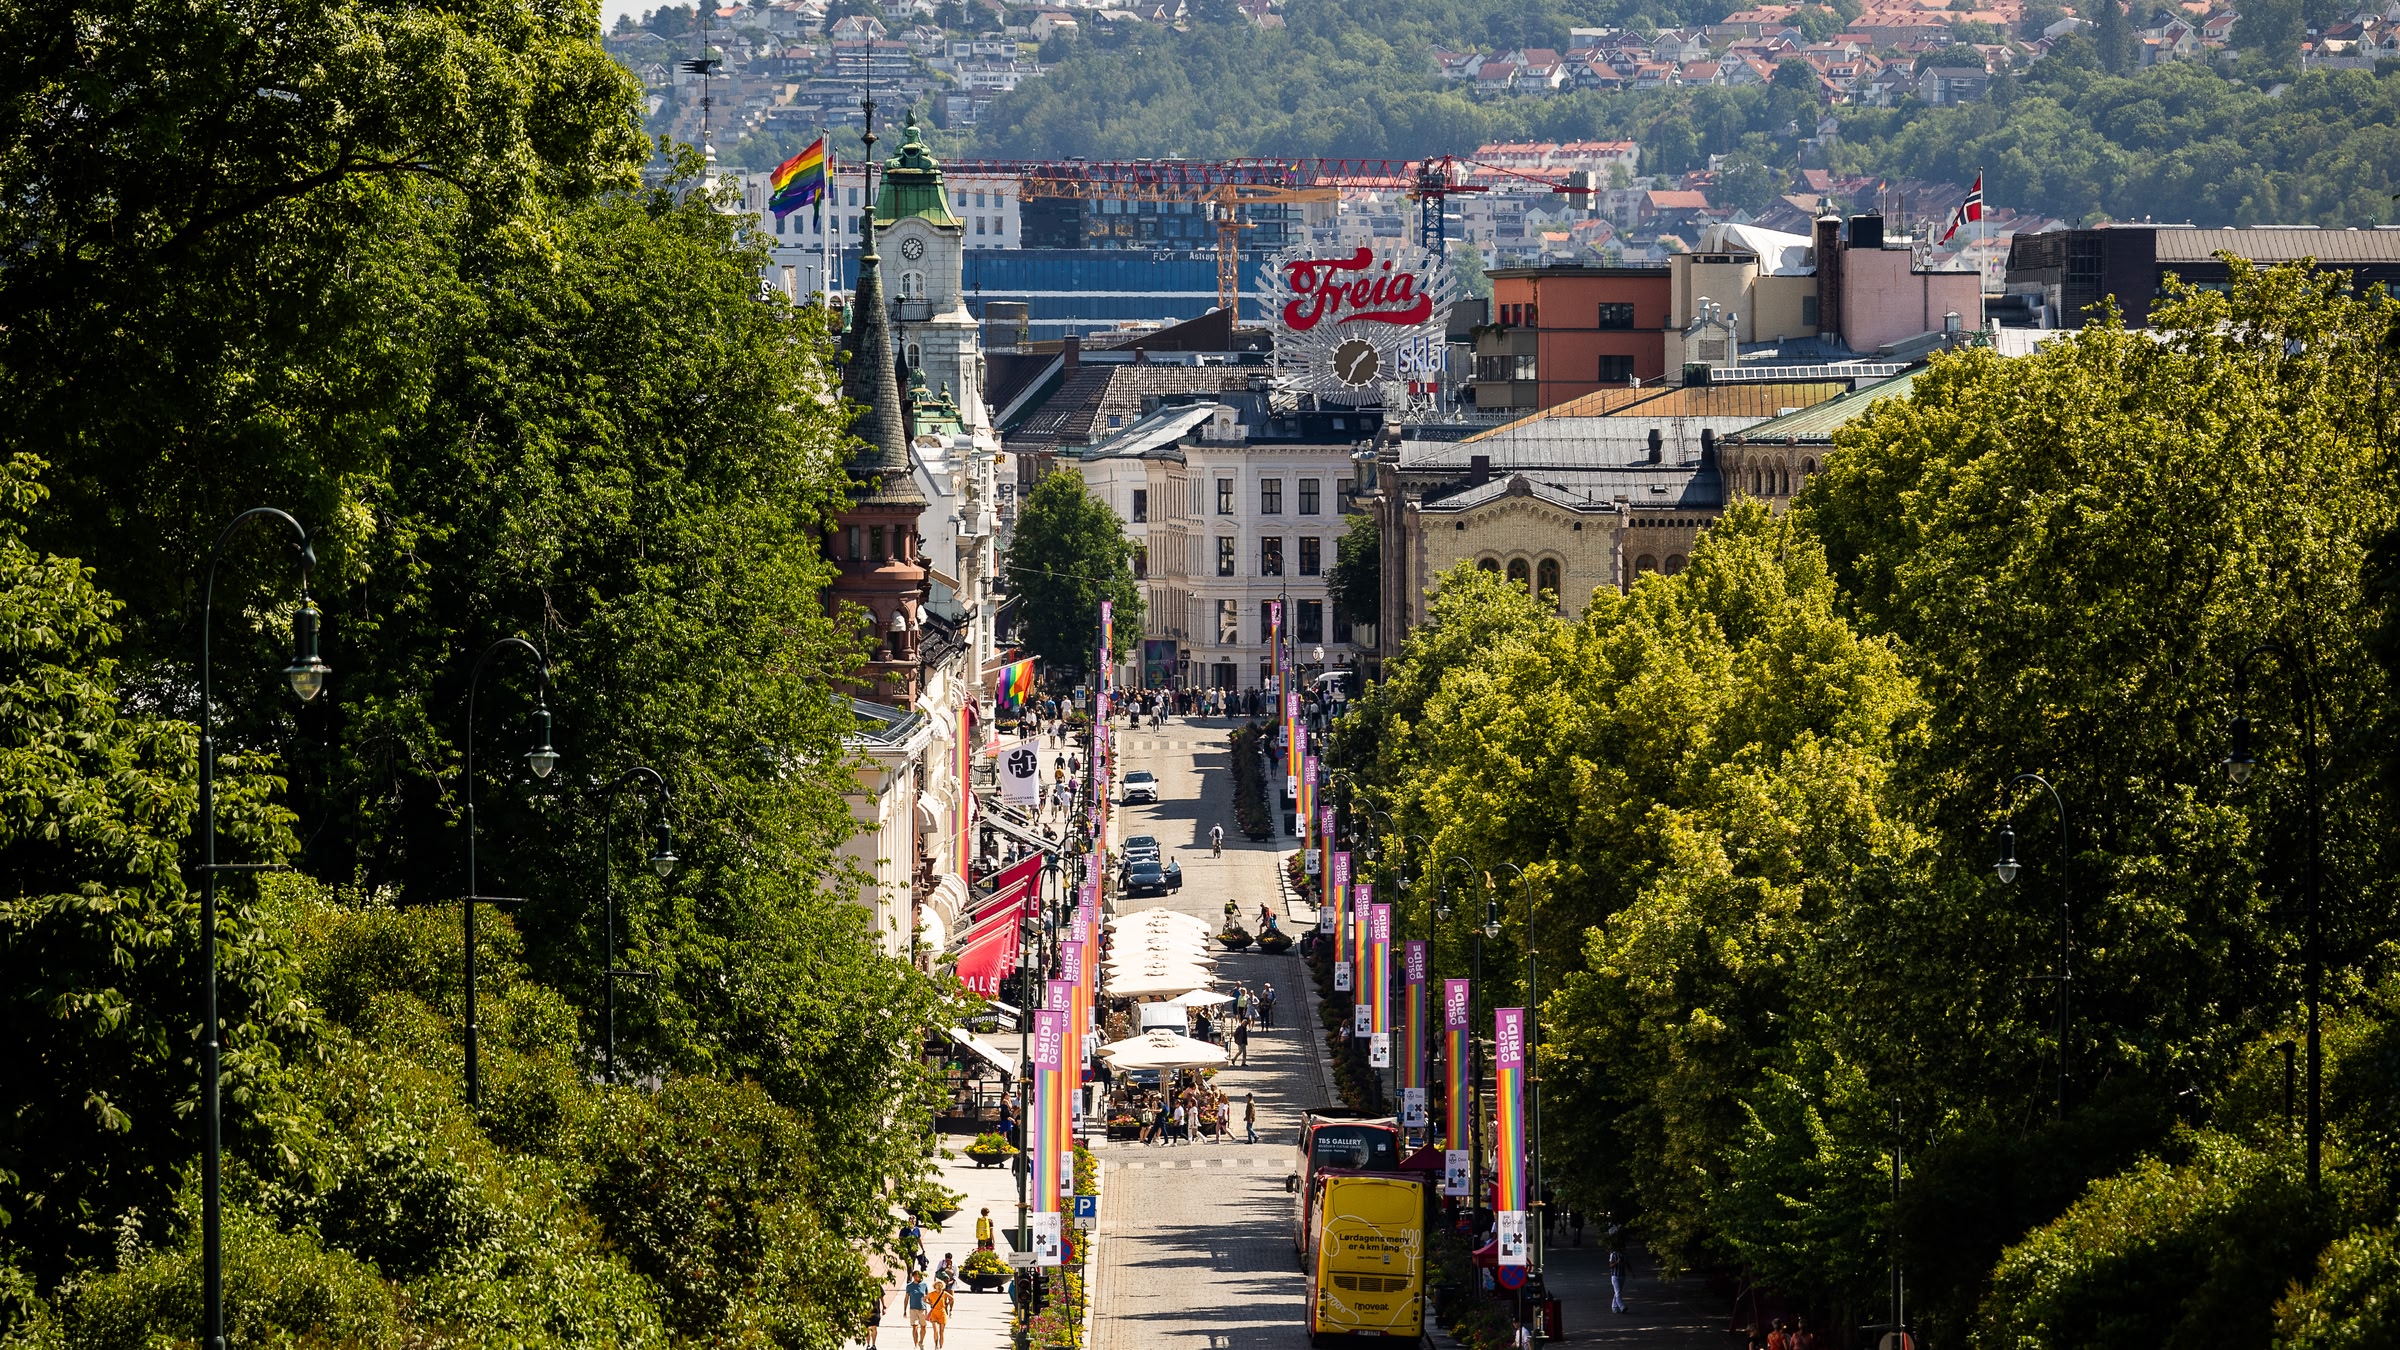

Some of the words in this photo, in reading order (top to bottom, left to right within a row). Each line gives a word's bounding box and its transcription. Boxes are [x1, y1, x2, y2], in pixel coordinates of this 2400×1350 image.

[1282, 247, 1432, 331] Freia
[1340, 856, 1348, 881] PRIDE
[1361, 888, 1370, 916] PRIDE
[1379, 909, 1387, 938] PRIDE
[1413, 944, 1424, 979] PRIDE
[1448, 999, 1457, 1026] OSLO
[1453, 984, 1466, 1025] PRIDE
[1499, 1031, 1510, 1062] OSLO
[1505, 1014, 1521, 1062] PRIDE
[1079, 1199, 1091, 1215] P
[1340, 1234, 1384, 1243] Lørdagens
[1386, 1237, 1410, 1245] meny
[1381, 1244, 1399, 1253] lang
